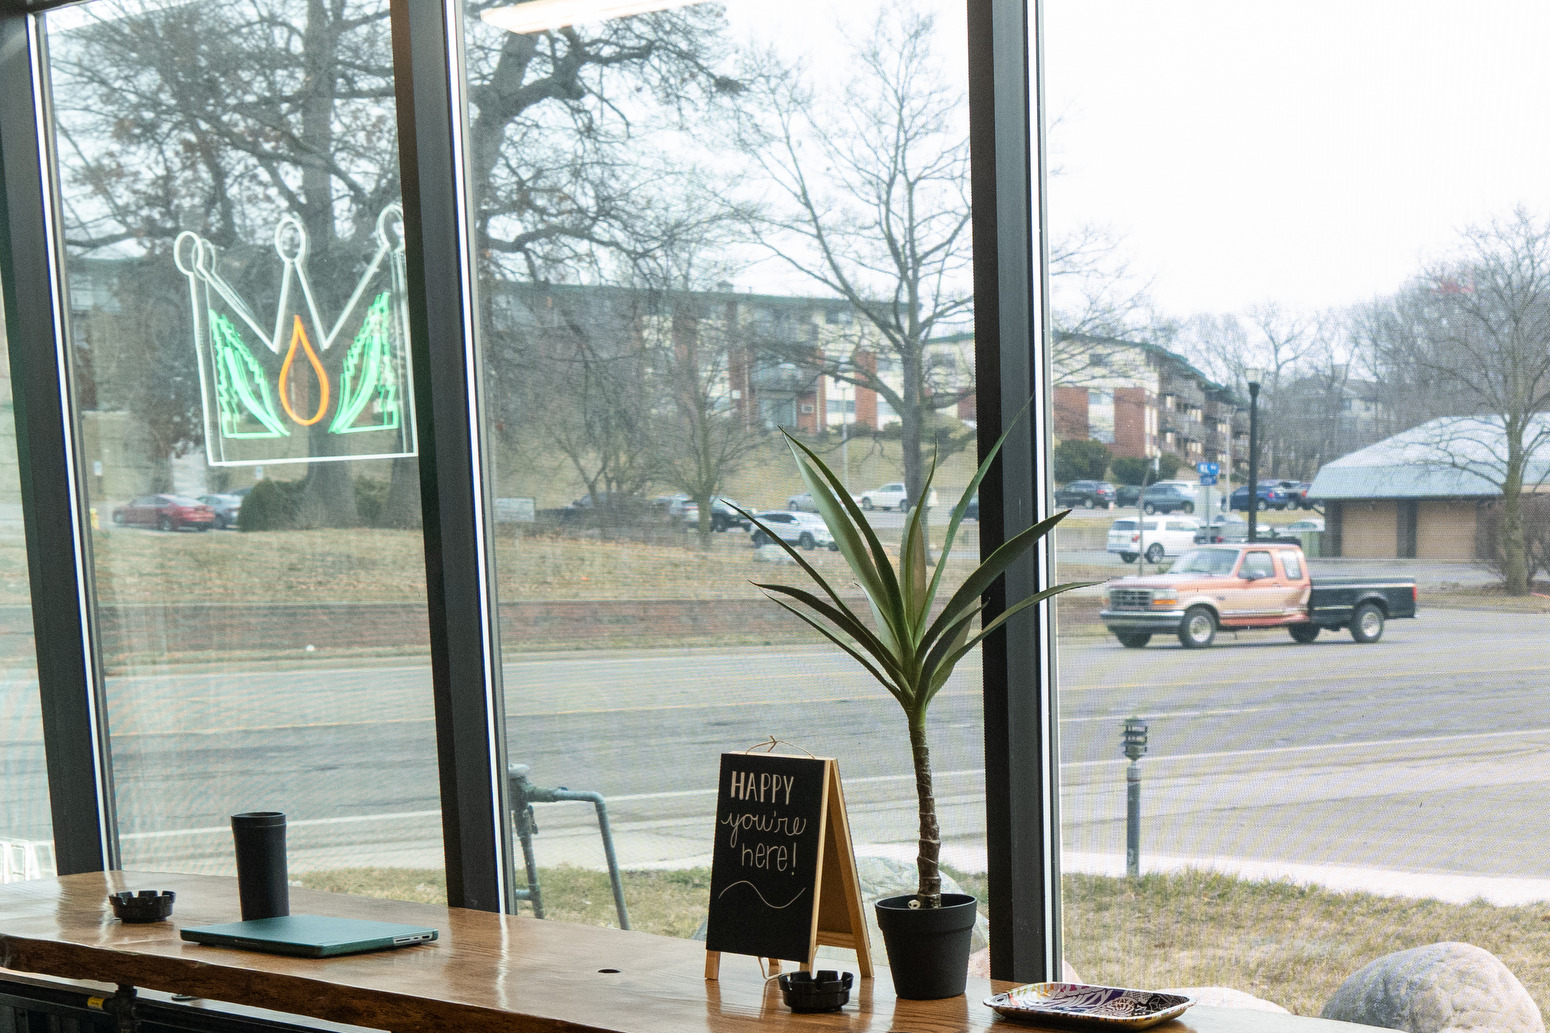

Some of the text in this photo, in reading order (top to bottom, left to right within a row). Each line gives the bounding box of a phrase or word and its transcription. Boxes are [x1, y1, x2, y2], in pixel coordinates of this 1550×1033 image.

[730, 770, 795, 805] HAPPY
[720, 811, 807, 849] you're
[741, 842, 797, 876] here!
